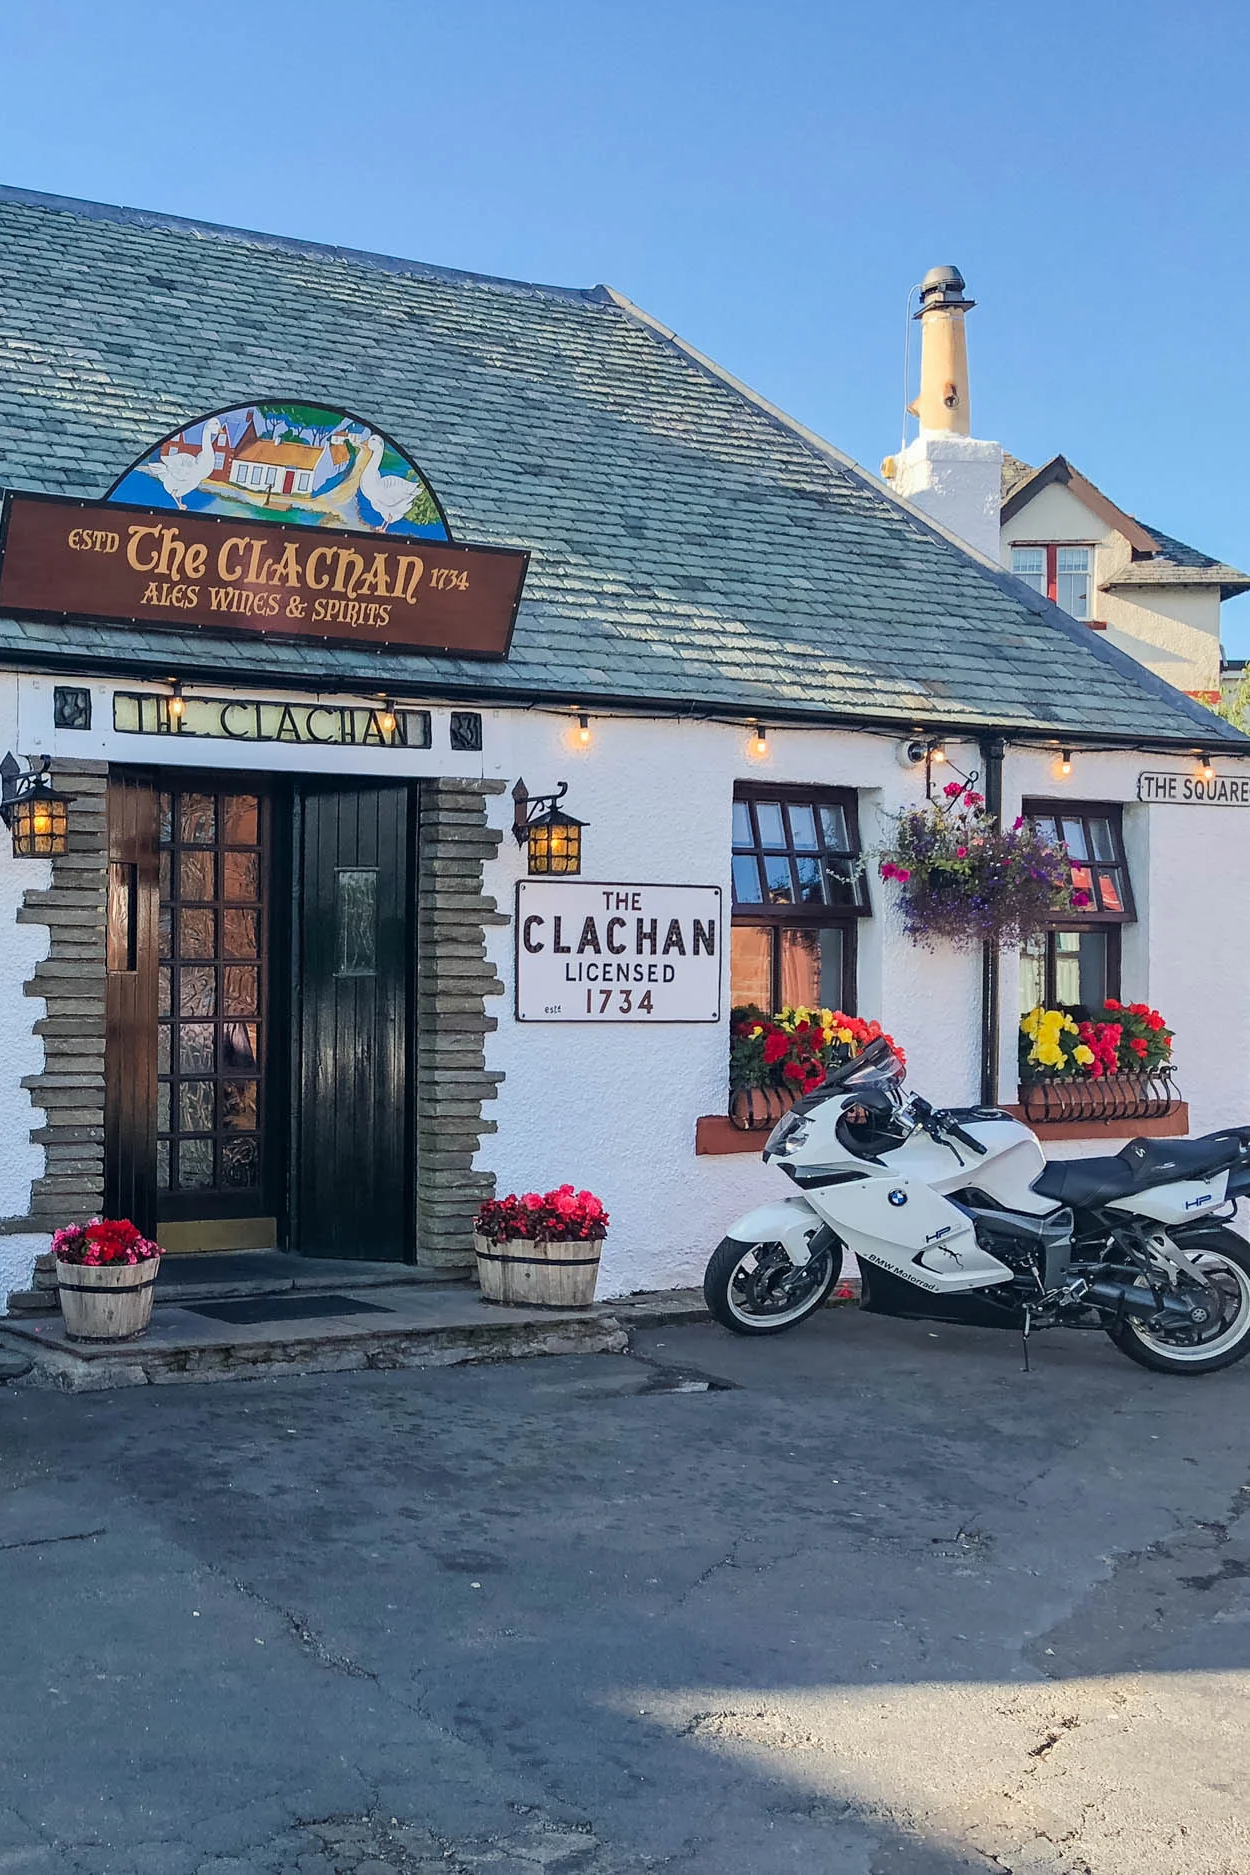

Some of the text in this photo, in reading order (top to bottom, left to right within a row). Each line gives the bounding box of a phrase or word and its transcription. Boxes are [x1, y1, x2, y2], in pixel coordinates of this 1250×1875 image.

[67, 527, 120, 553] ESTD
[126, 523, 209, 582] The
[429, 567, 470, 591] 1734
[140, 581, 393, 628] ALES WINES & SPIRITS
[129, 695, 408, 745] THE CLACHAN
[1144, 776, 1249, 802] THE SQUARE
[602, 891, 642, 911] THE
[523, 914, 715, 956] CLACHAN
[565, 962, 675, 983] LICENSED
[586, 988, 654, 1014] 1734
[1185, 1194, 1212, 1210] HP
[925, 1226, 951, 1243] HP
[868, 1254, 936, 1290] BMW Motorrad
